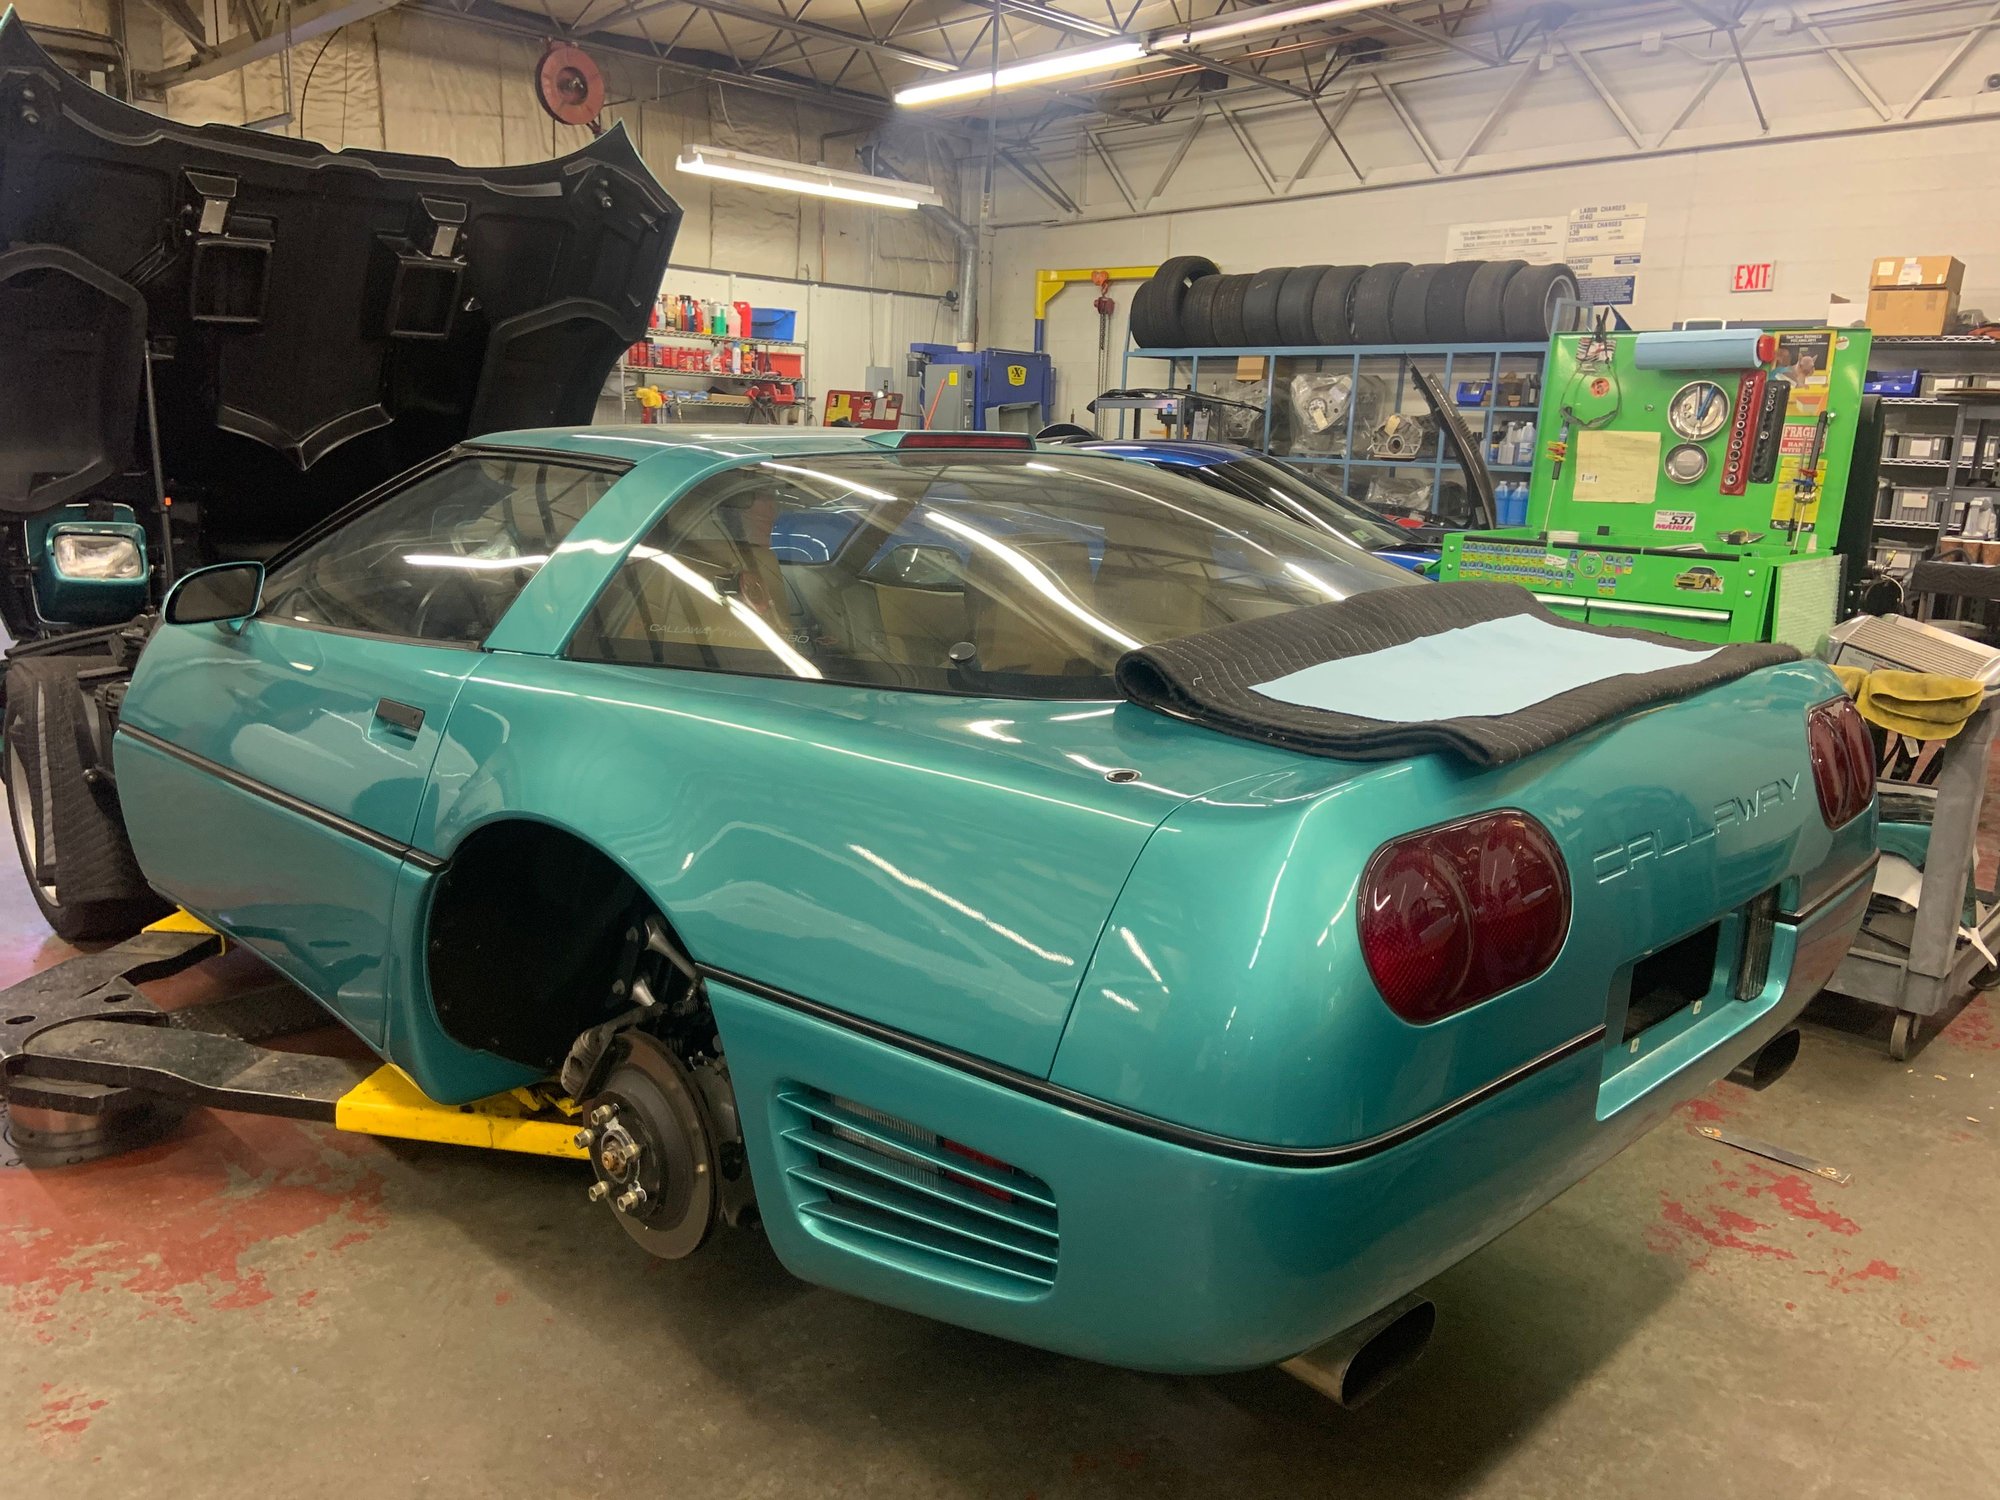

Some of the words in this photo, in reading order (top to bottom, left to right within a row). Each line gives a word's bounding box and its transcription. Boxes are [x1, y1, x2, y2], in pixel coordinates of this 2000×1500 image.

[1600, 204, 1626, 212] CHARGES
[1735, 264, 1771, 289] EXIT
[1670, 515, 1694, 525] 537
[650, 623, 718, 639] CALLAWAY
[1593, 771, 1800, 884] CALLAWAY
